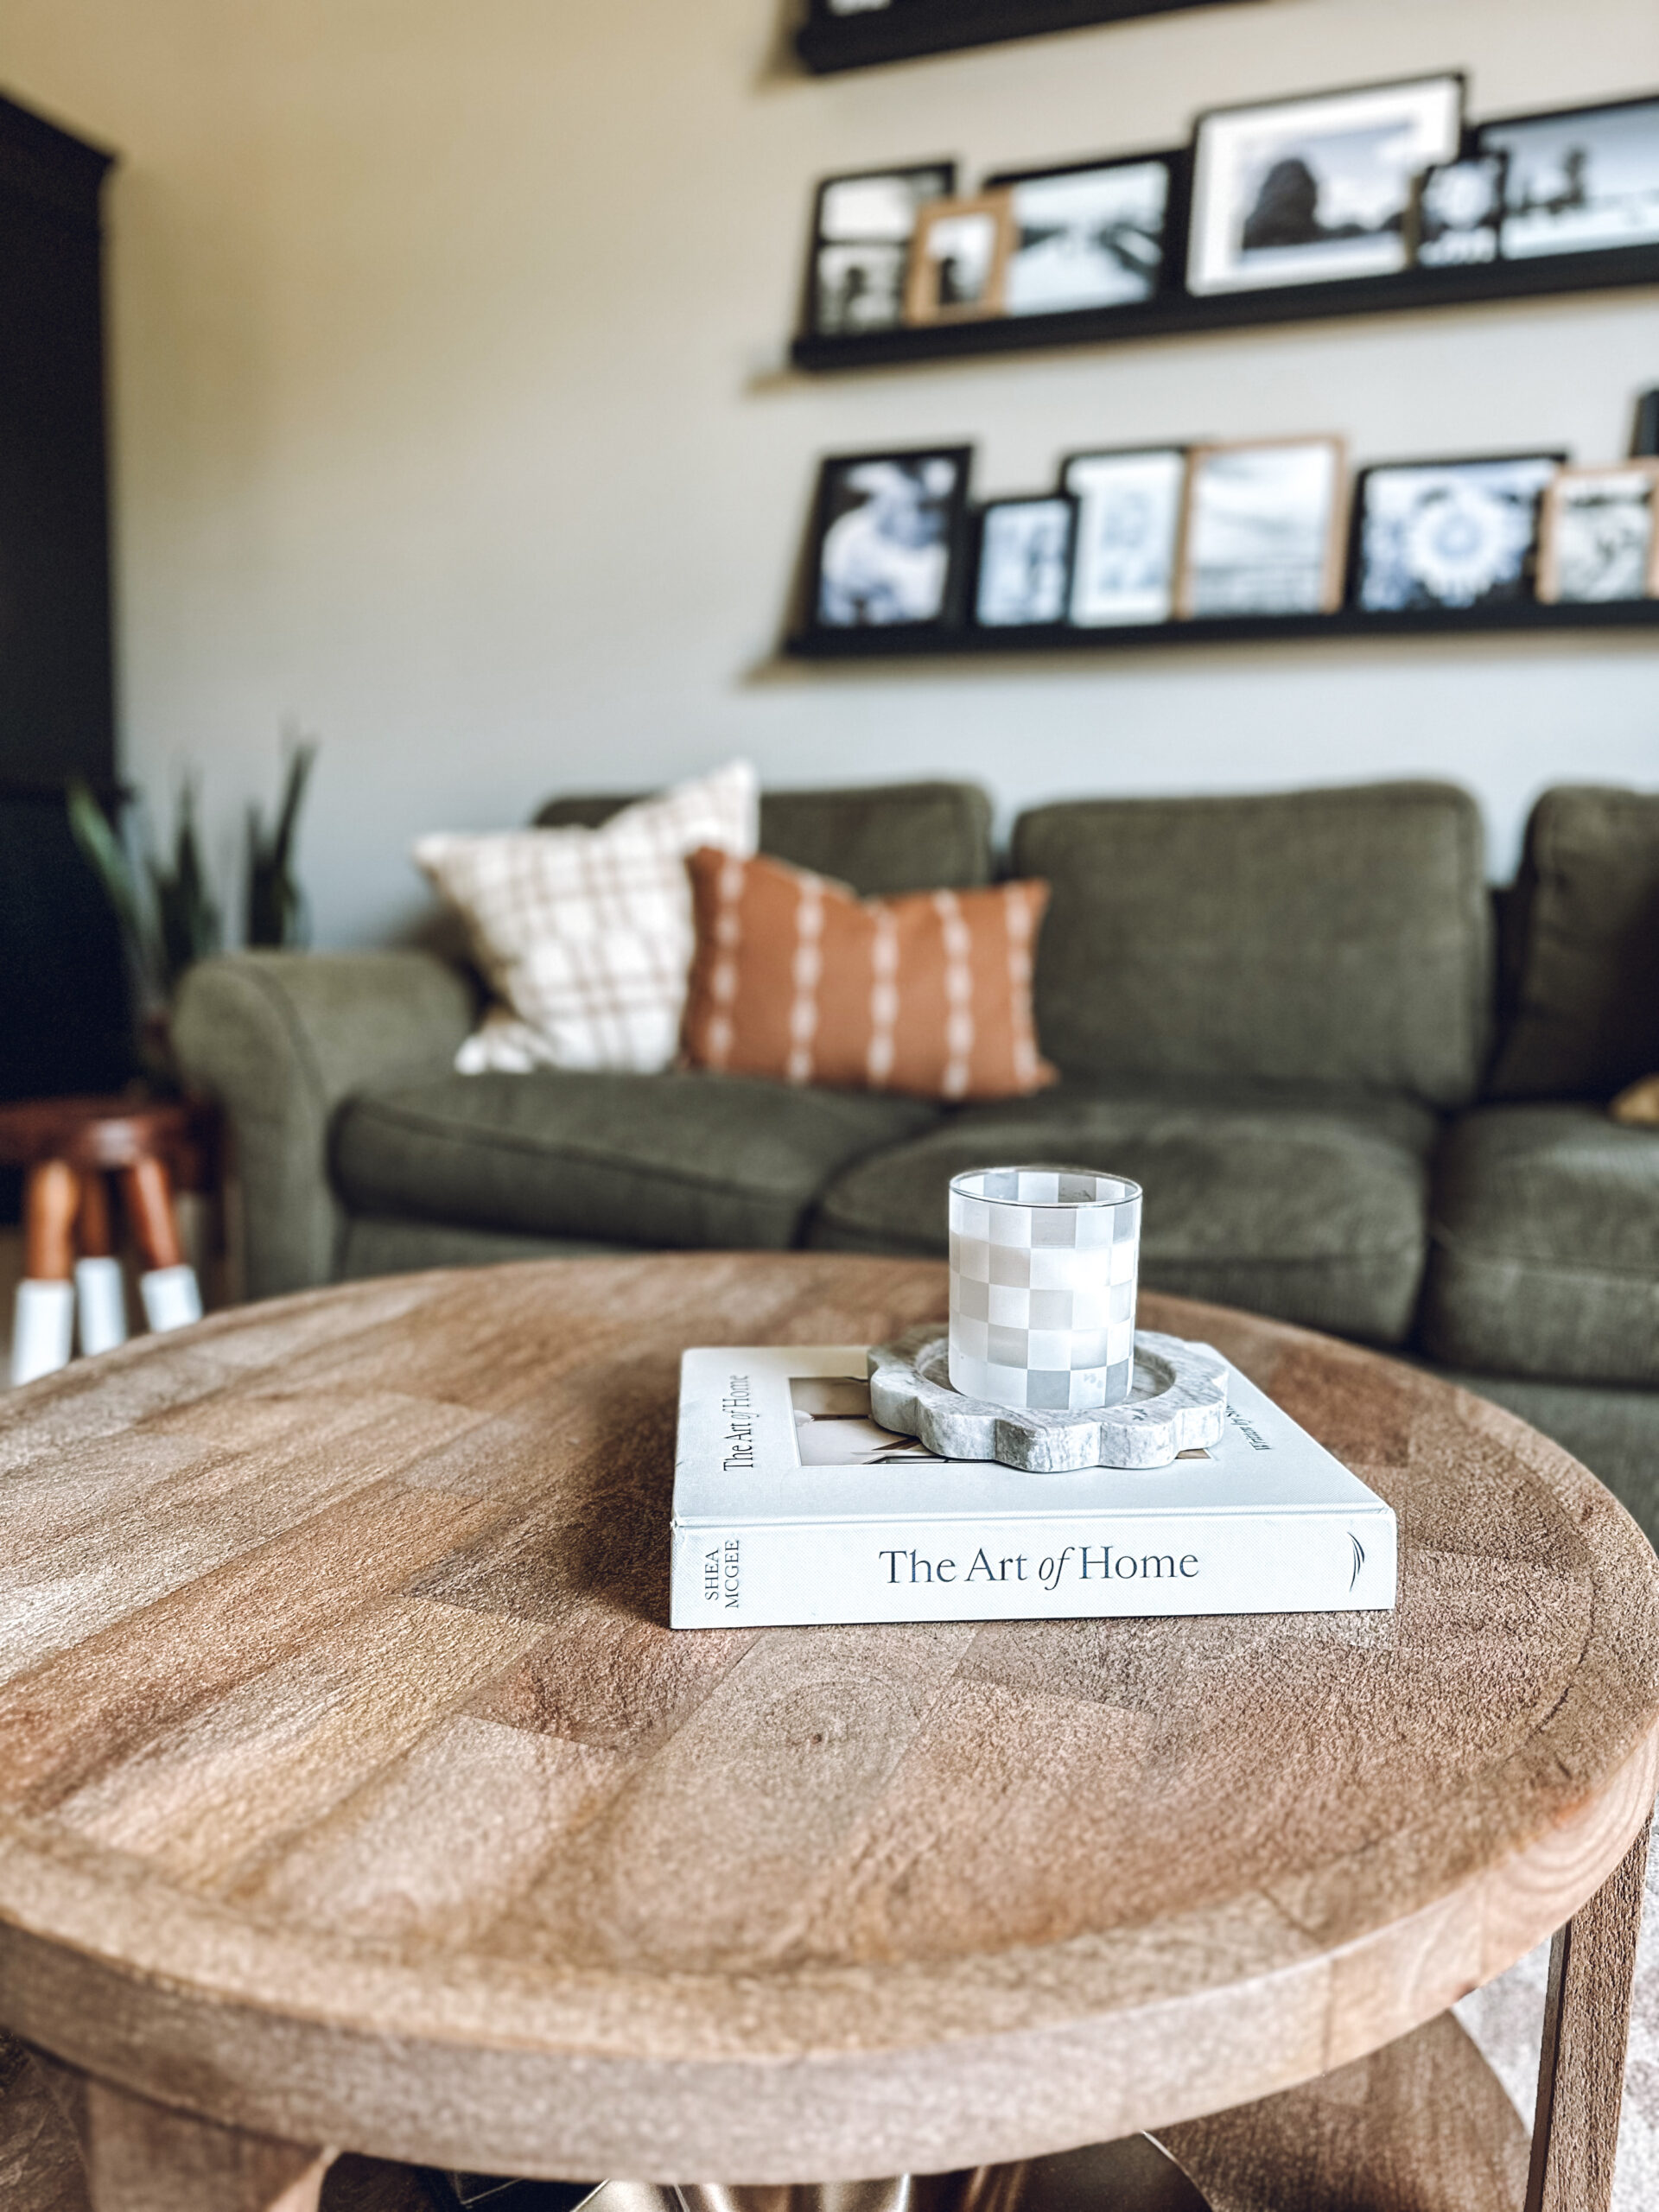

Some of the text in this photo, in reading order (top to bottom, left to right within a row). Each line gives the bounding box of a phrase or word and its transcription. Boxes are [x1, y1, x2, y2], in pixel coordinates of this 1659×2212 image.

[722, 1375, 760, 1471] The Art of Home
[704, 1549, 719, 1601] SHEA
[724, 1539, 740, 1610] MCGEE
[879, 1546, 1199, 1591] The Art of Home
